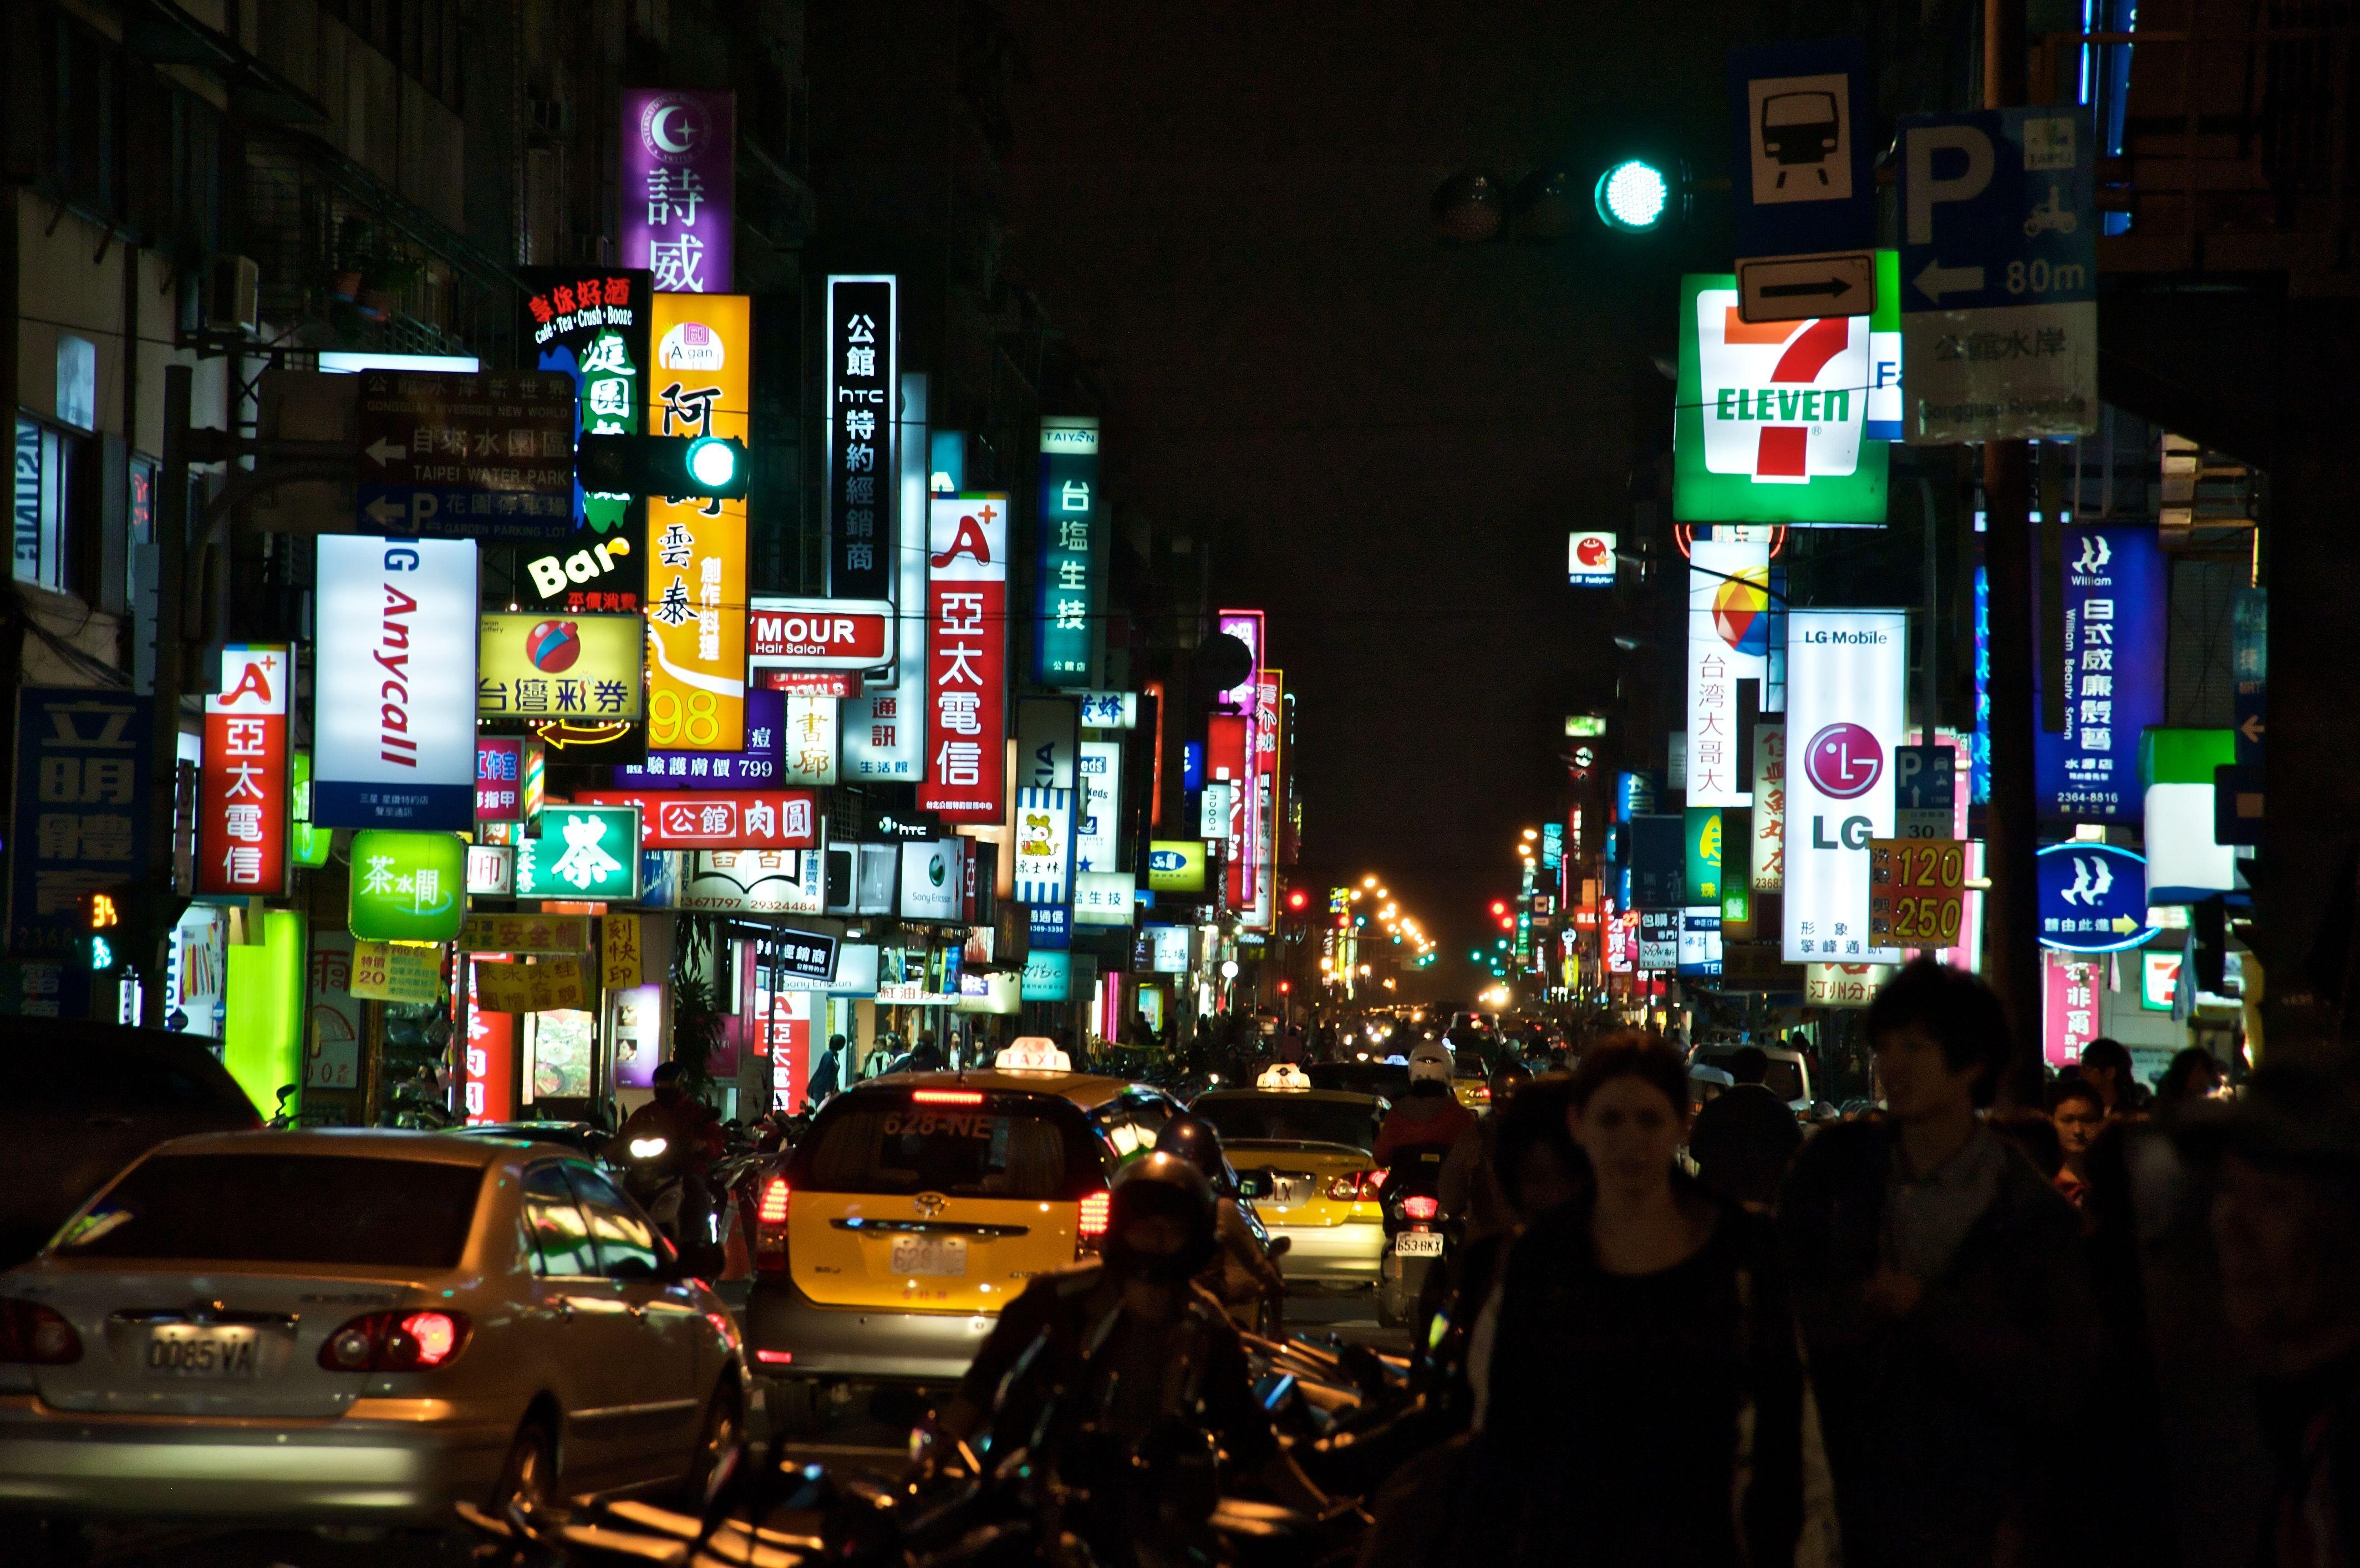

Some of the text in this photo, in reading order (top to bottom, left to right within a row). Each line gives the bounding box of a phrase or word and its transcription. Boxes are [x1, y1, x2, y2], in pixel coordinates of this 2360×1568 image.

[1905, 125, 1996, 245] P
[647, 166, 705, 293] 詩威
[2007, 259, 2084, 294] 80m
[557, 315, 573, 333] Tea
[577, 305, 602, 327] Crush
[607, 305, 632, 326] Booze
[846, 313, 876, 377] 公館
[582, 335, 636, 435] 庭園
[498, 406, 522, 417] NEW
[528, 408, 568, 419] WORLD
[414, 427, 569, 457] 自來水園區
[412, 465, 567, 486] TAIPEI WATER PARK
[846, 409, 876, 570] 特約經銷商
[409, 492, 438, 534] P
[653, 383, 722, 627] 阿雲泰
[546, 526, 566, 538] LOT
[527, 536, 631, 599] Bar
[1056, 480, 1090, 630] 台塩生技
[2071, 575, 2112, 586] William
[699, 557, 721, 660] 創作料理
[1805, 630, 1888, 644] LG Mobile
[2064, 608, 2077, 652] William
[755, 642, 826, 655] Hair Salon
[1053, 660, 1086, 673] 公館店
[374, 582, 417, 768] Anycall
[937, 592, 984, 785] 亞太電信
[479, 678, 628, 714] 台灣彩券
[648, 689, 719, 745] 98
[872, 696, 897, 747] 通訊
[2063, 706, 2074, 741] Salon
[792, 696, 830, 779] 書廊
[477, 750, 517, 781] 工作室
[738, 760, 772, 777] 799
[860, 761, 908, 774] 生活館
[1081, 760, 1104, 772] eds
[1900, 751, 1922, 788] P
[223, 719, 265, 885] 亞太電信
[668, 799, 812, 839] 公館 肉圓
[1813, 815, 1874, 851] LG
[1908, 825, 1935, 839] 30
[360, 855, 439, 915] 茶水間
[1899, 846, 1964, 888] 120
[750, 900, 817, 912] 29324484
[912, 892, 930, 904] Sony
[1894, 895, 1962, 939] 250
[2044, 917, 2110, 933] 請由此進
[359, 970, 385, 985] 20
[1005, 1053, 1058, 1066] TAXI
